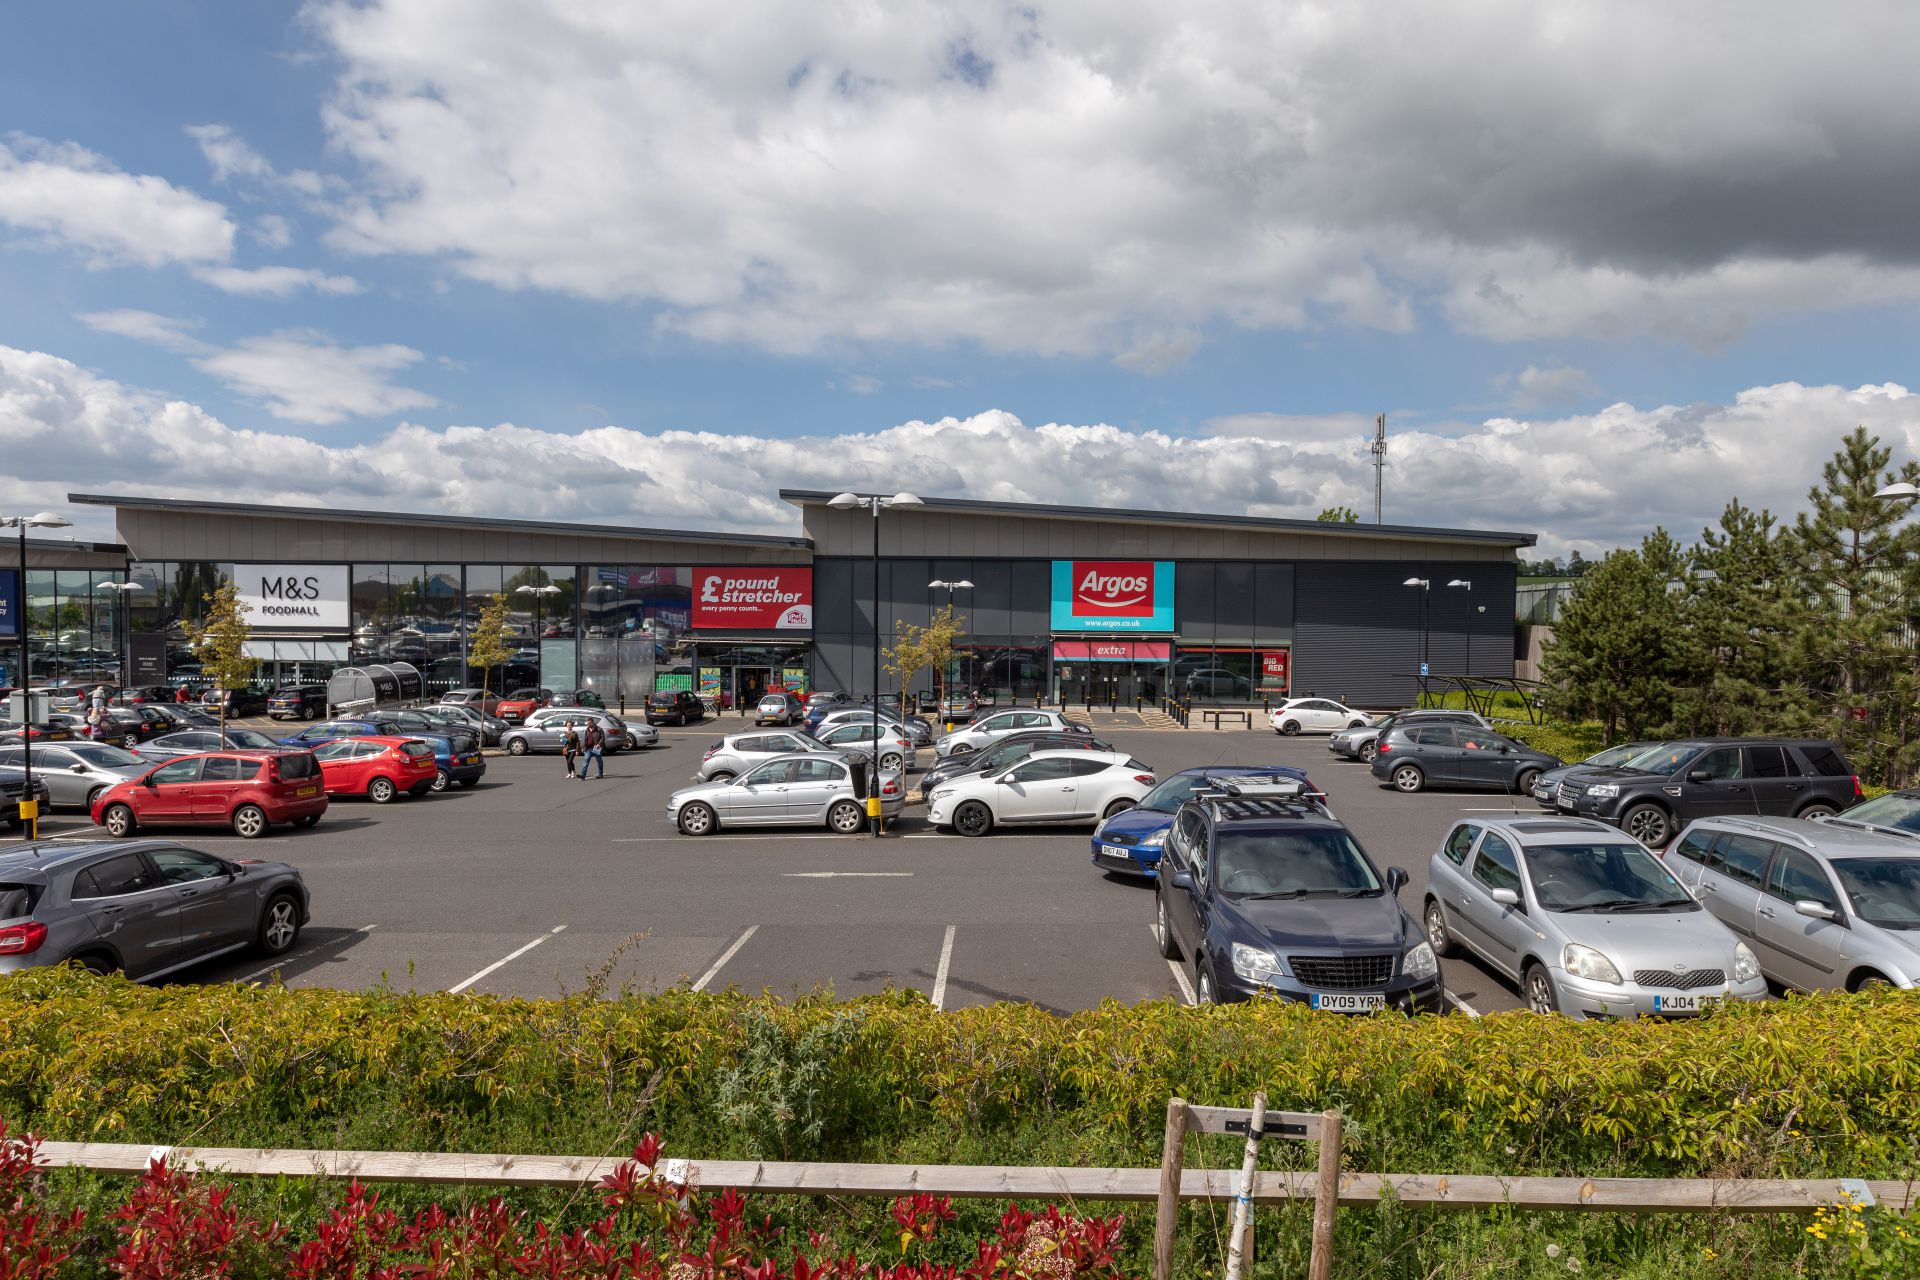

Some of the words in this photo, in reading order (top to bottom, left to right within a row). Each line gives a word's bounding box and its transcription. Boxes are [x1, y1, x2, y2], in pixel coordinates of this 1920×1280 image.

[262, 576, 319, 600] M&S
[724, 576, 779, 592] pound
[1079, 571, 1148, 598] Argos
[721, 589, 802, 603] stretcher
[262, 605, 320, 616] FOODHALL
[719, 605, 737, 613] penny
[1085, 620, 1140, 628] www.argos.co.uk
[1097, 645, 1126, 655] extra
[1263, 657, 1277, 665] BIG
[1267, 664, 1284, 672] RED
[1322, 995, 1355, 1008] OY09
[1360, 996, 1383, 1008] YRN
[1661, 996, 1695, 1009] KJ04
